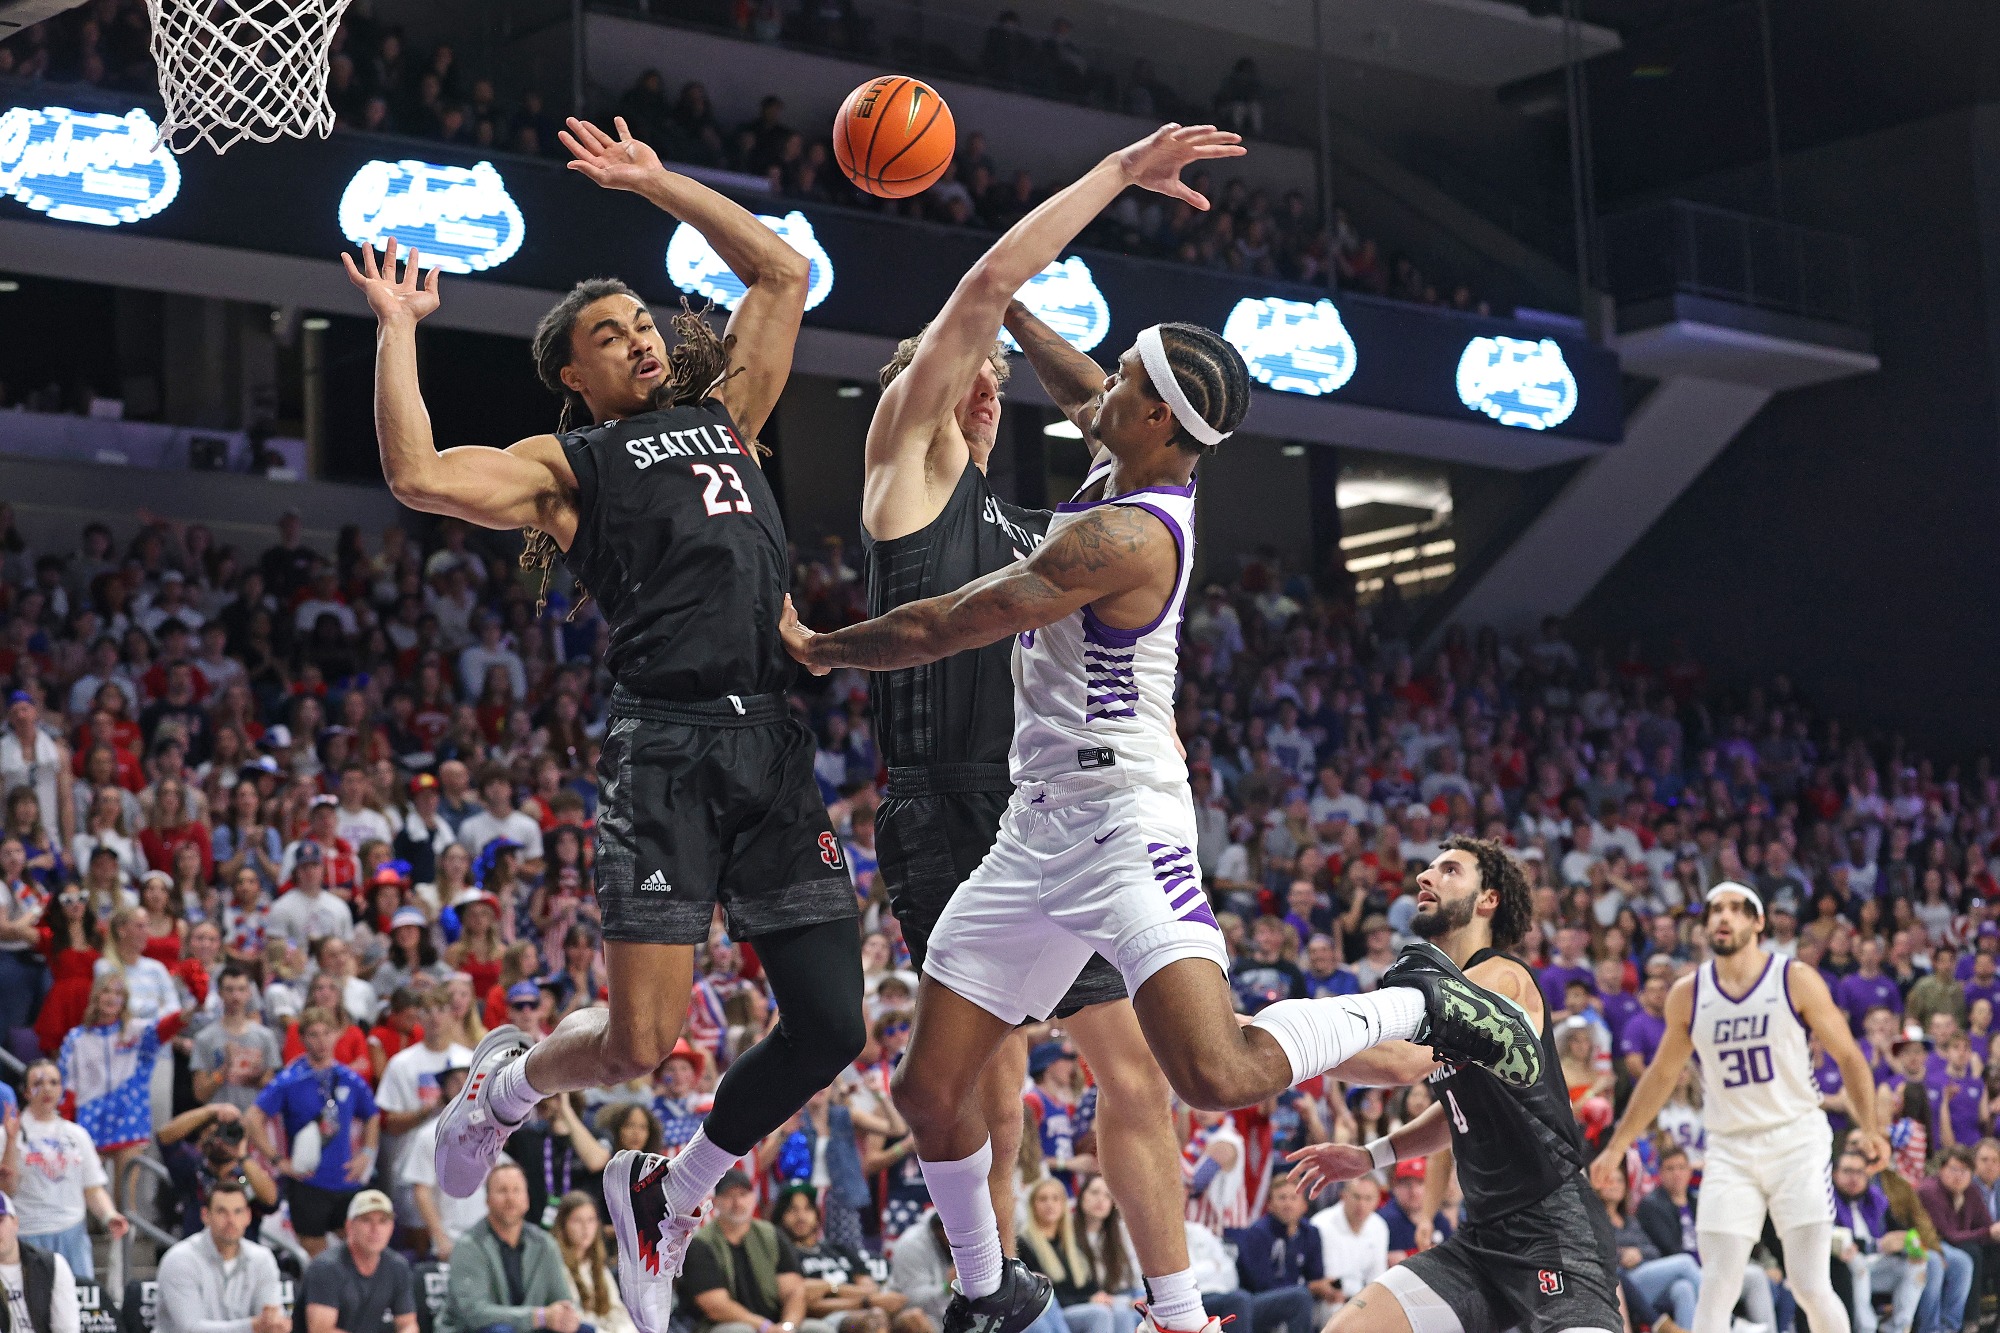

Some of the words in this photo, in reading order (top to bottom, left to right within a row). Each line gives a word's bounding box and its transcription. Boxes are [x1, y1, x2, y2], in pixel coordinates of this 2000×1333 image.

[857, 77, 899, 118] ELITE
[690, 463, 752, 517] 23
[640, 882, 672, 892] adidas
[1714, 1014, 1769, 1044] GCU
[1719, 1045, 1775, 1088] 30
[1446, 1089, 1469, 1134] 0
